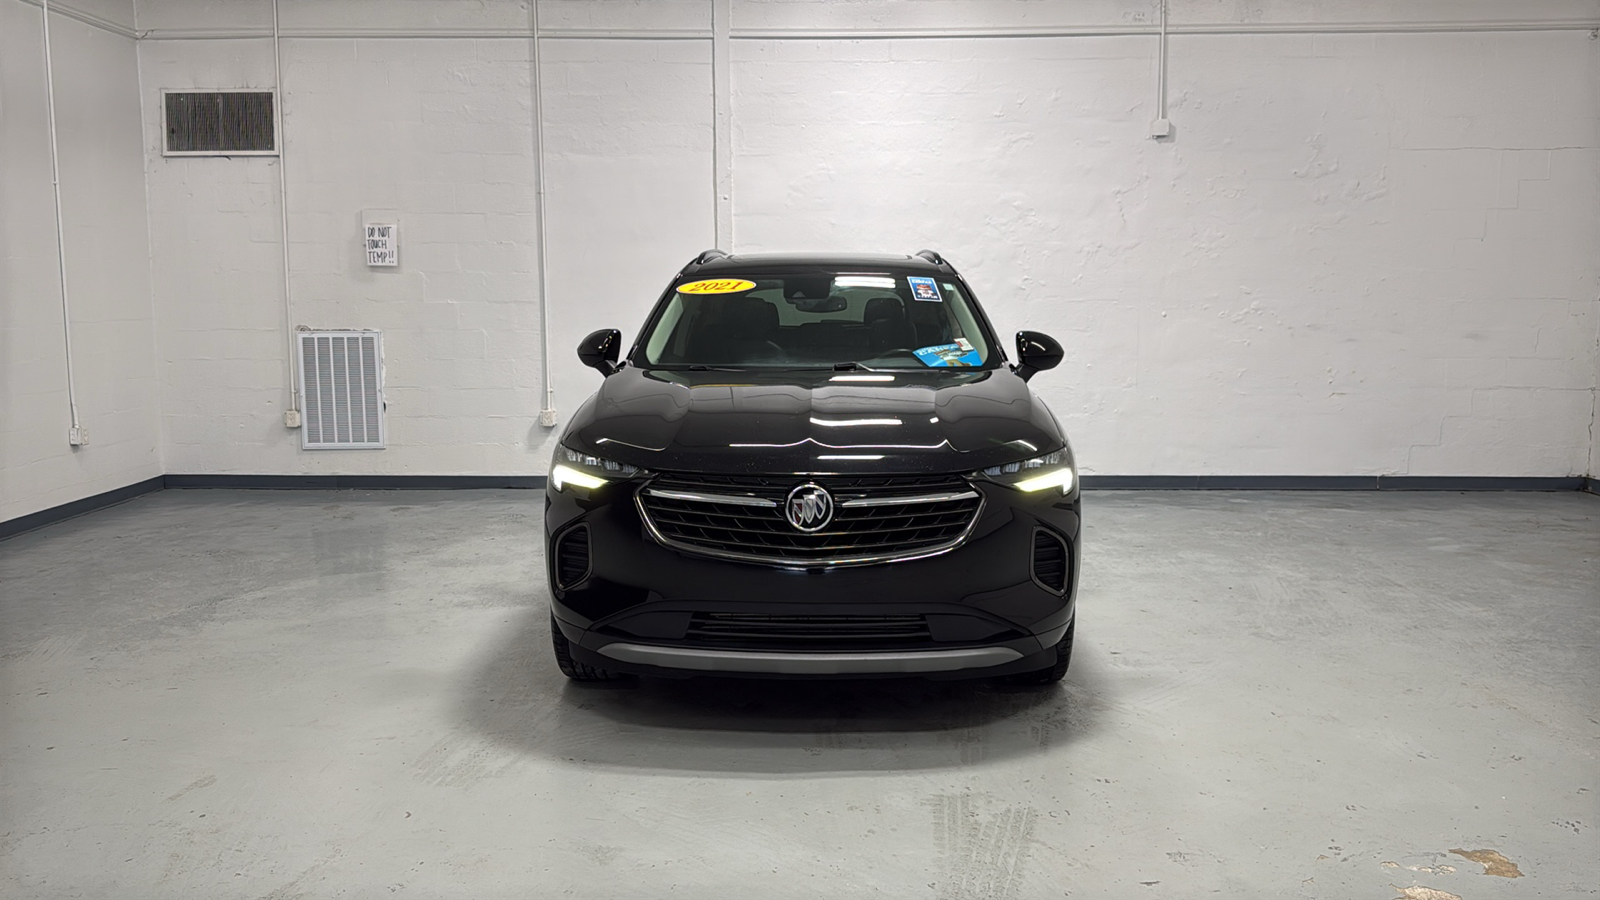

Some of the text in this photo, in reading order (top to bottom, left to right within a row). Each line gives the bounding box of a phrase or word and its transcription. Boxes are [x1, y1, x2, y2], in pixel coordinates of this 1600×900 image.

[368, 227, 392, 238] DO NOT
[367, 239, 387, 249] TOUCH
[368, 250, 394, 263] TEMP!!
[688, 281, 744, 292] 2021
